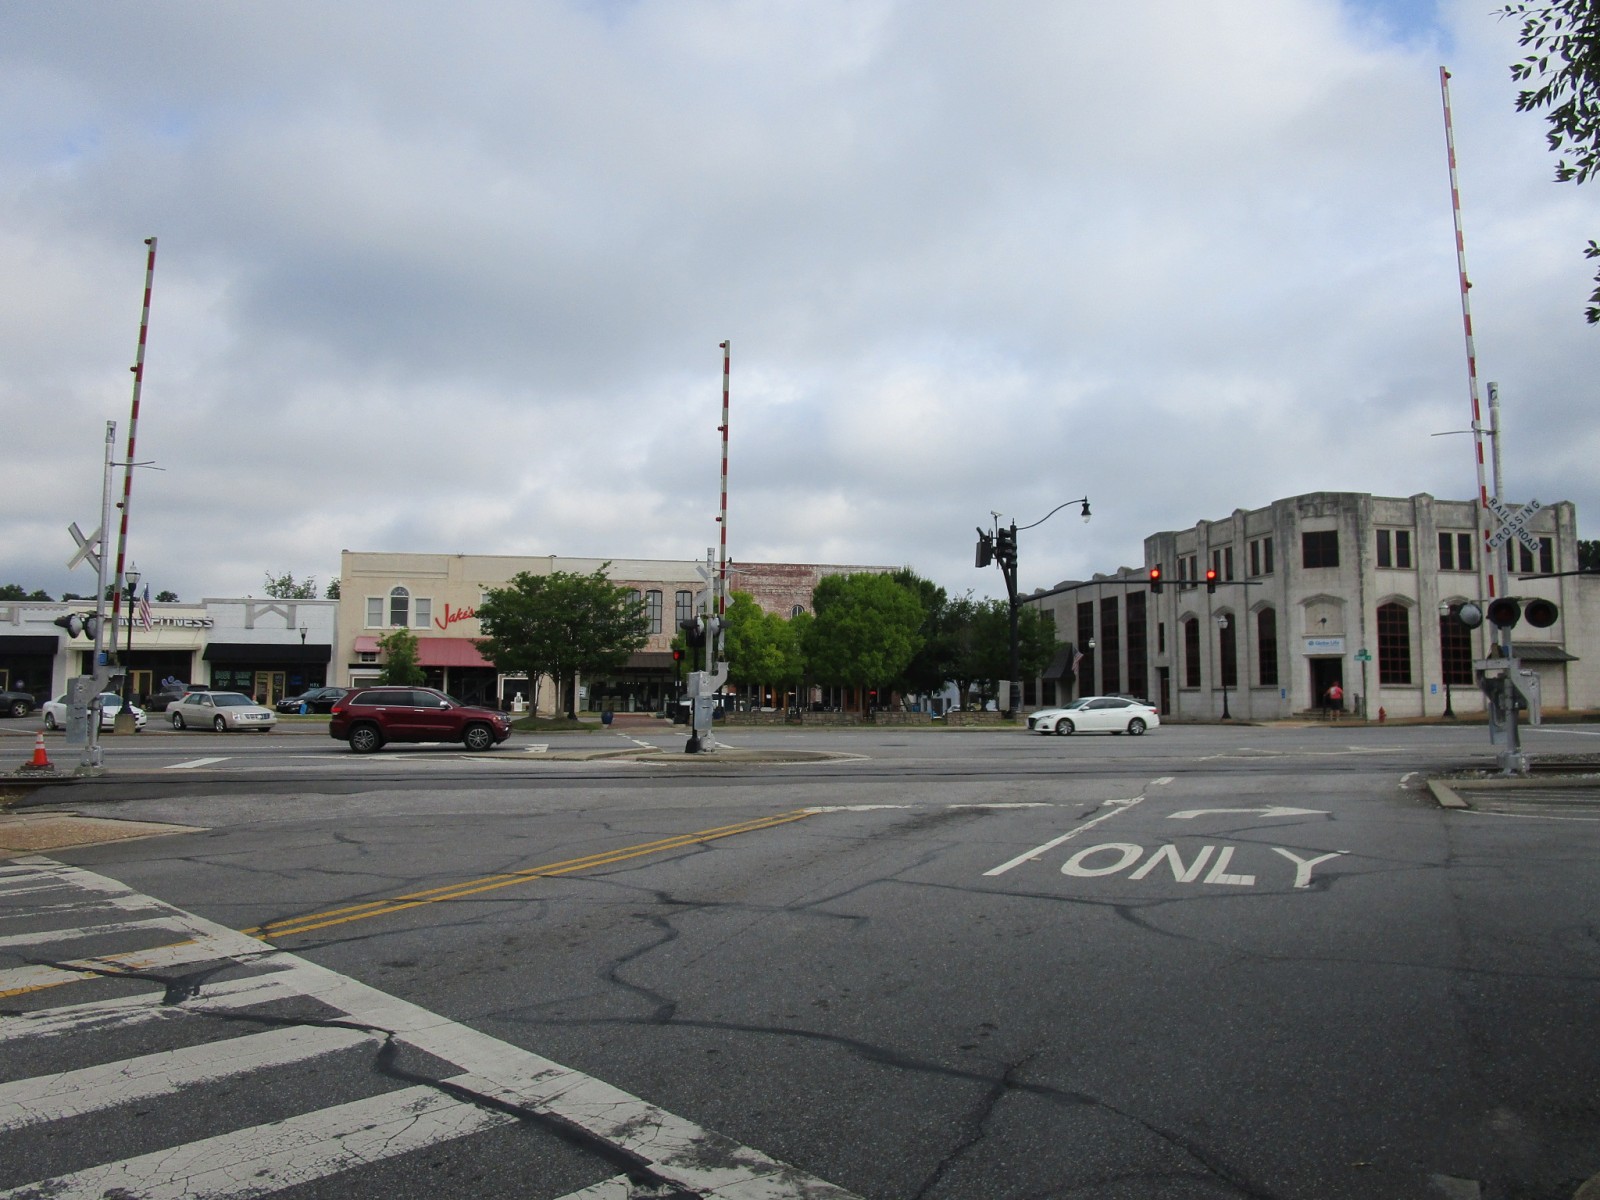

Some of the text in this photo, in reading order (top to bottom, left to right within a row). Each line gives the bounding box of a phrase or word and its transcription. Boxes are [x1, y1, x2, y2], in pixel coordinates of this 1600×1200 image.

[1489, 498, 1538, 550] RAIL ROAD
[1489, 500, 1540, 548] CROSSING
[151, 617, 213, 628] FITNESS
[435, 603, 475, 630] Jake's
[1061, 842, 1351, 888] ONLY
